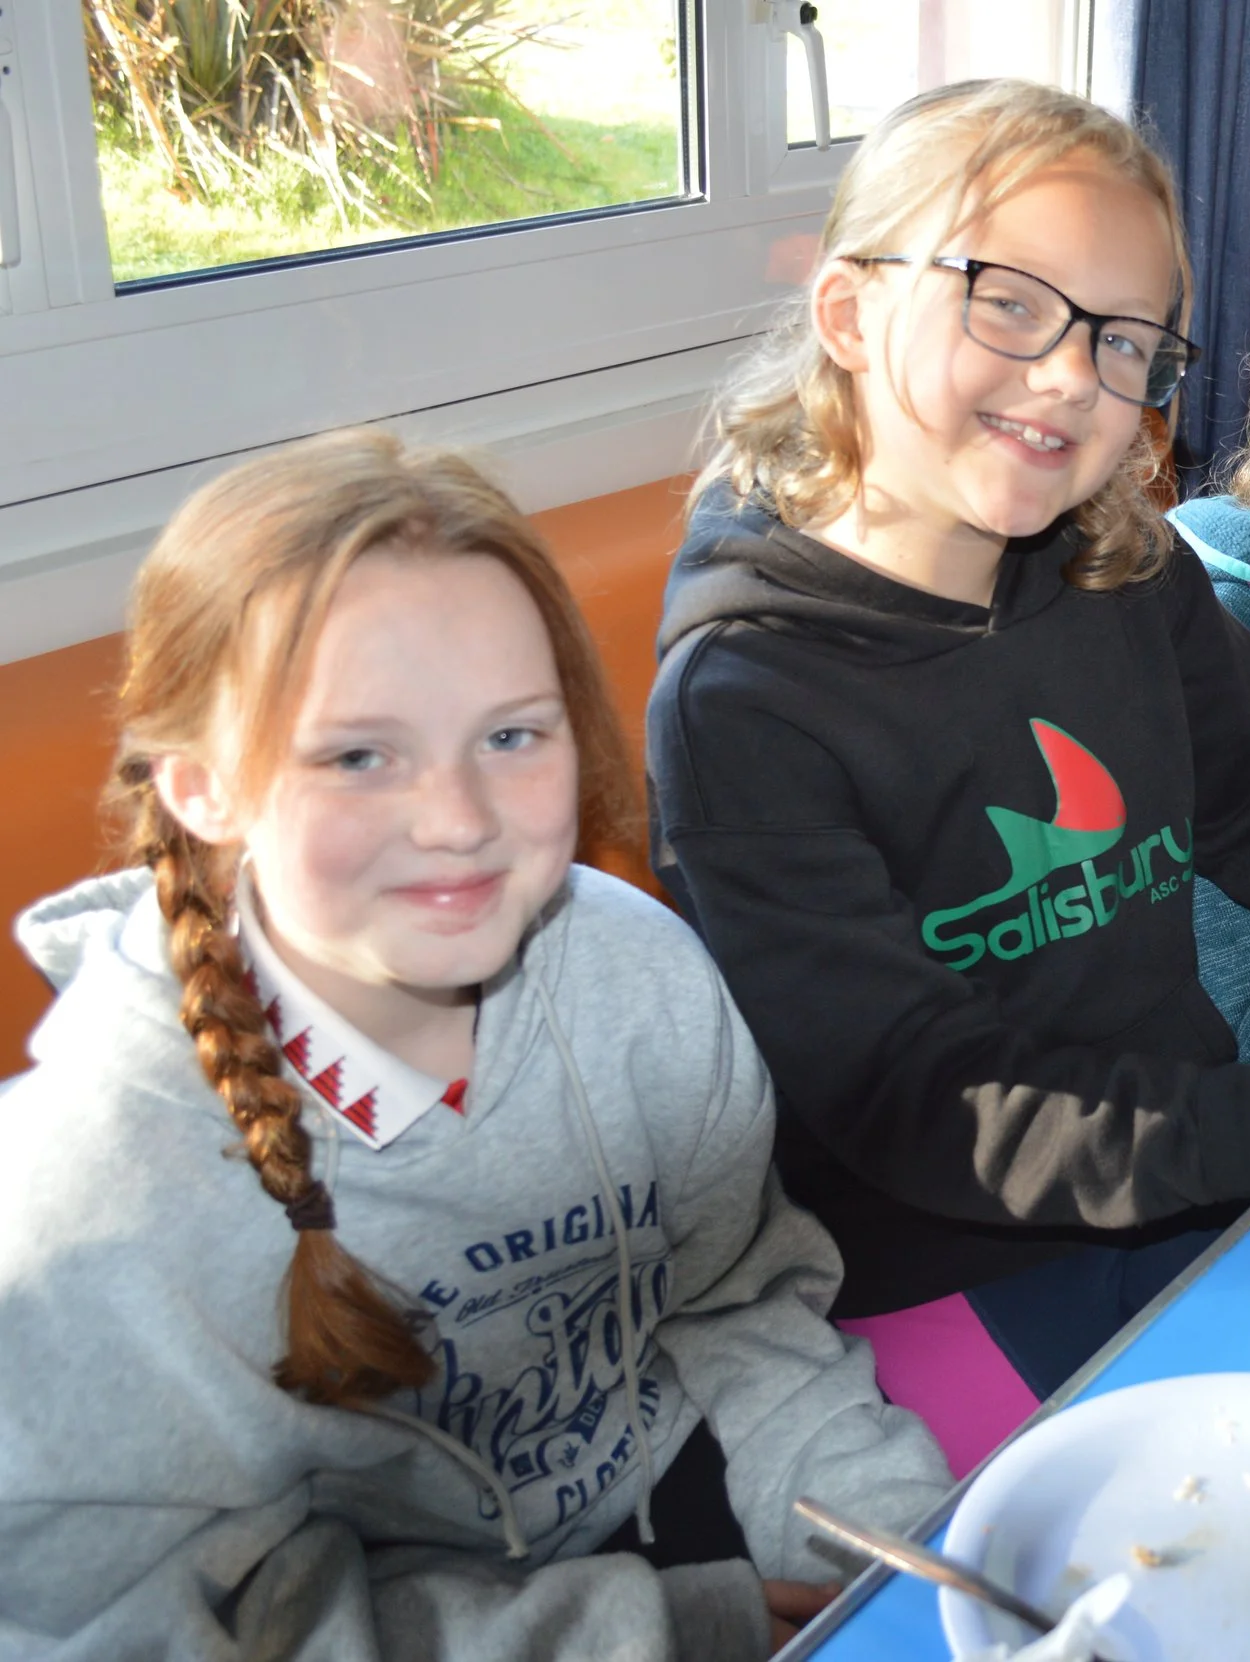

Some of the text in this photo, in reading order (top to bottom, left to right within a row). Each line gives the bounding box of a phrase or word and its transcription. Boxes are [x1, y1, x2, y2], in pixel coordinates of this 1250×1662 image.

[921, 816, 1194, 972] Salisbury
[1150, 875, 1180, 904] ASC
[464, 1180, 659, 1273] ORIGINA
